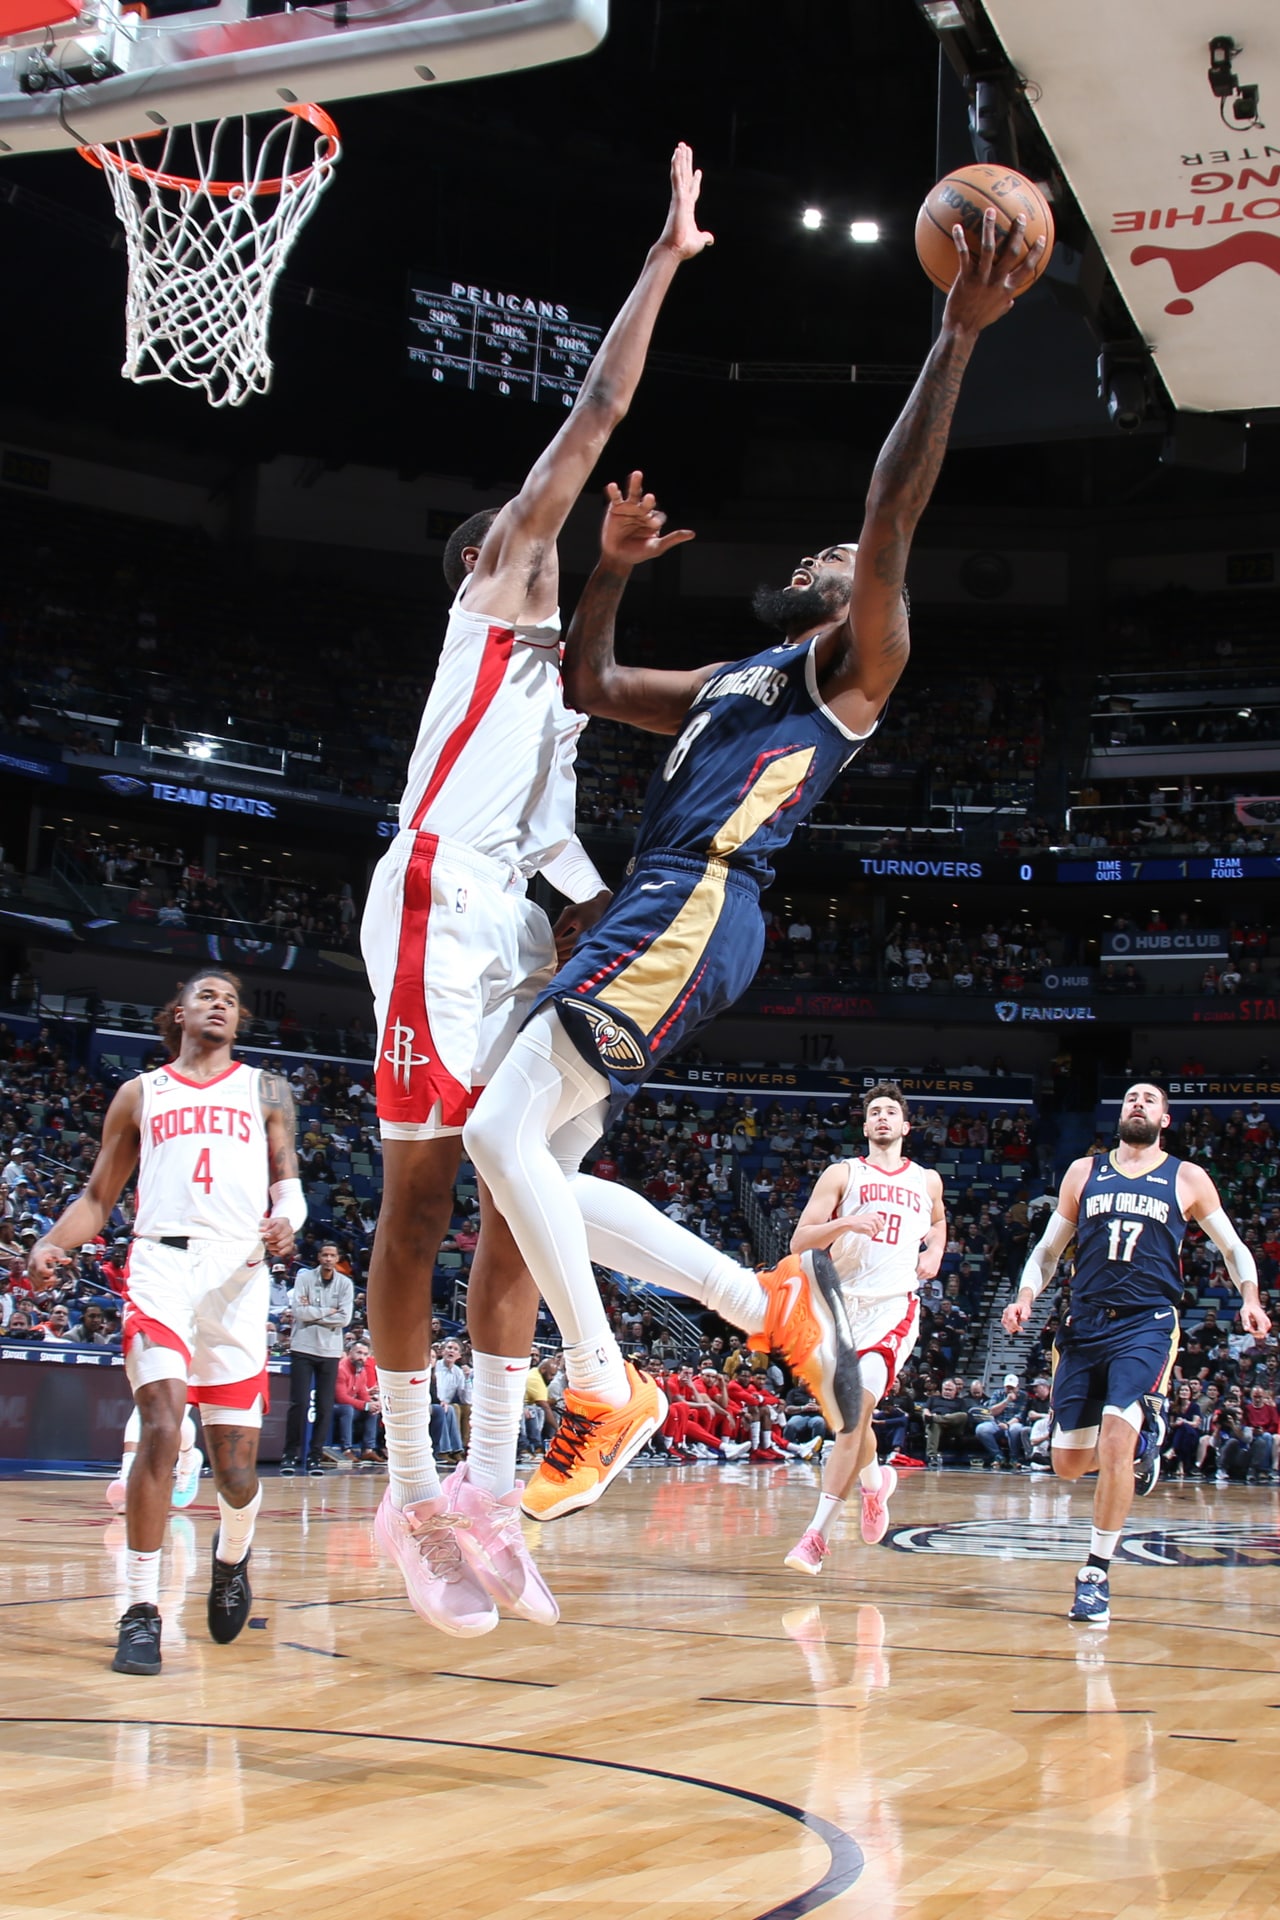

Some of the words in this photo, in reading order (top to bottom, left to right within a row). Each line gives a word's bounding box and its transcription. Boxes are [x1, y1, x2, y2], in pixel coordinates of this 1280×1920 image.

[452, 282, 569, 321] PELICANS
[491, 321, 529, 342] 100%
[554, 335, 592, 354] 100%
[501, 351, 513, 366] 2
[564, 364, 576, 379] 3
[662, 711, 713, 782] 8
[150, 782, 208, 807] TEAM
[860, 859, 983, 878] TURNOVERS
[1019, 864, 1032, 881] 0
[1095, 870, 1122, 881] OUTS
[1210, 868, 1244, 879] FOULS
[1096, 860, 1121, 870] TIME
[1130, 862, 1142, 878] 7
[1178, 860, 1188, 878] 1
[1213, 857, 1241, 868] TEAM
[1135, 936, 1171, 949] HUB
[1174, 934, 1220, 948] CLUB
[1062, 976, 1089, 987] HUB
[253, 988, 287, 1019] 116
[1021, 1007, 1096, 1020] FANDUEL
[1239, 999, 1280, 1021] STA
[800, 1033, 834, 1061] 117
[687, 1070, 798, 1085] BETRIVERS
[1169, 1082, 1280, 1094] BETRIVERS
[151, 1106, 251, 1147] ROCKETS
[192, 1147, 213, 1195] 4
[860, 1183, 921, 1214] ROCKETS
[1086, 1192, 1115, 1219] NEW
[1115, 1192, 1170, 1224] ORLEANS
[1108, 1218, 1144, 1263] 17
